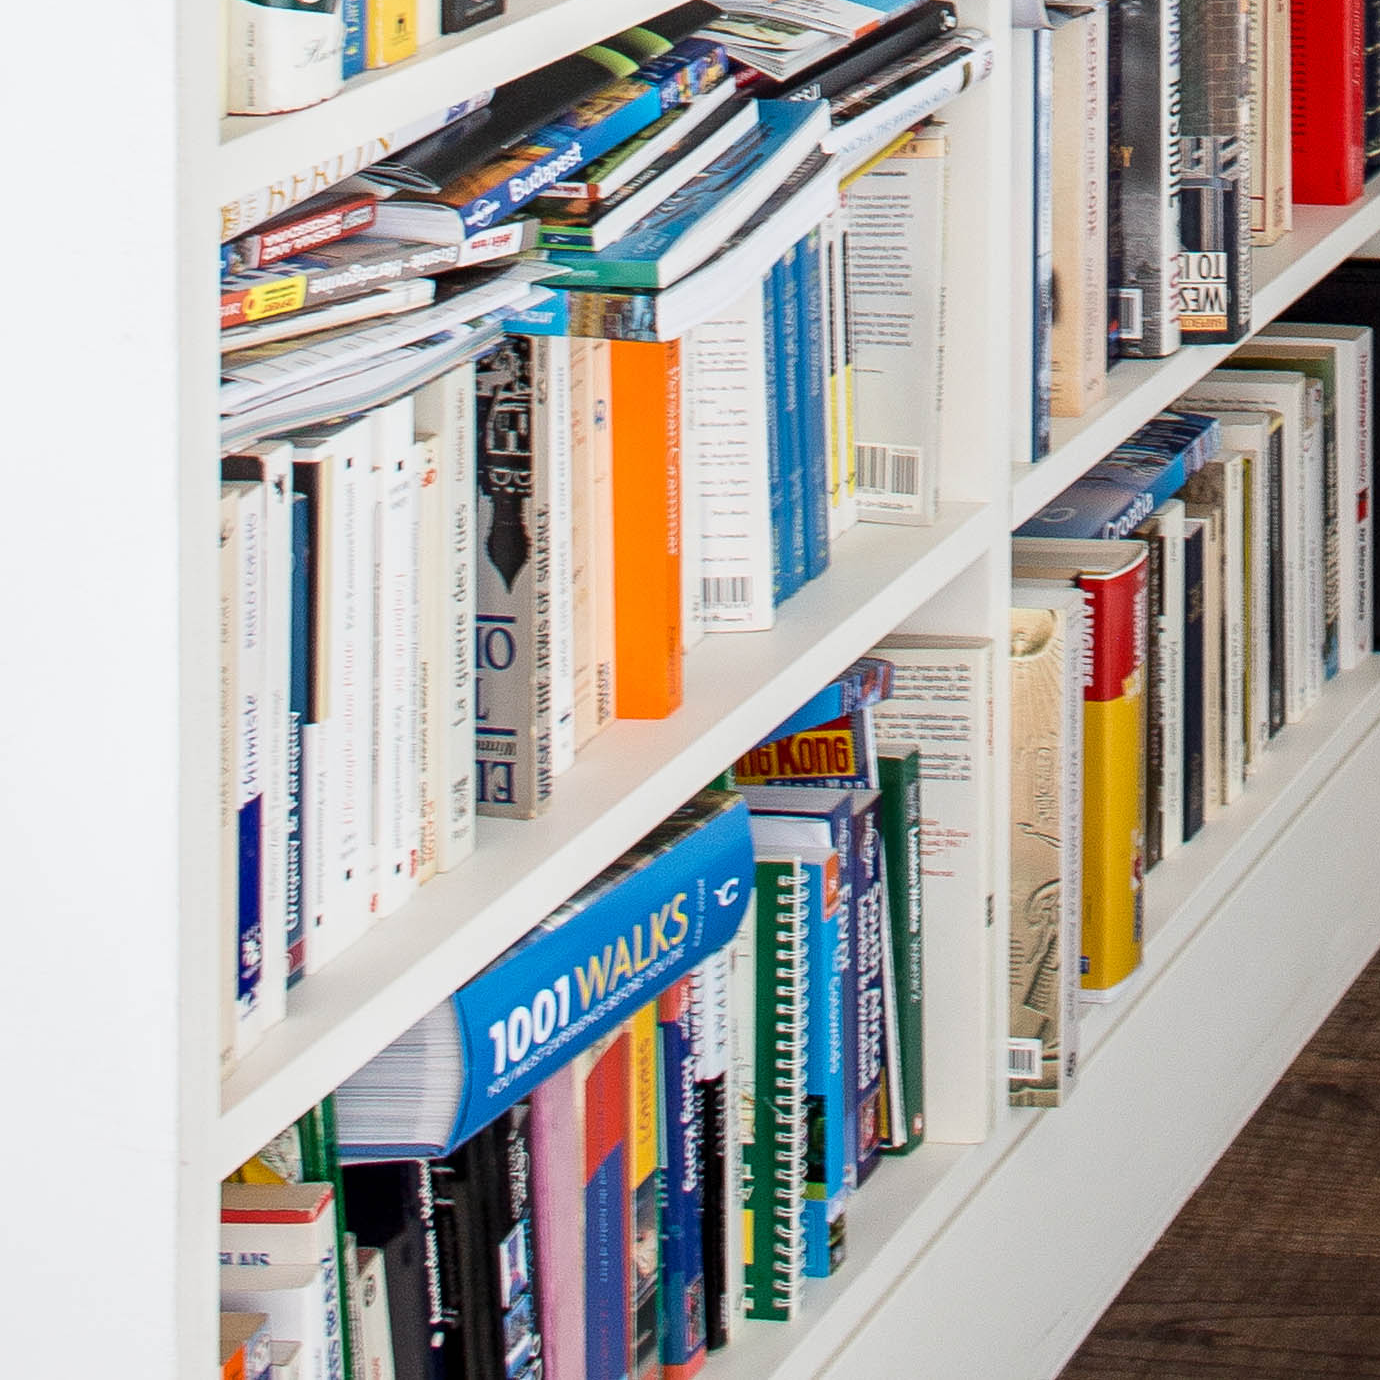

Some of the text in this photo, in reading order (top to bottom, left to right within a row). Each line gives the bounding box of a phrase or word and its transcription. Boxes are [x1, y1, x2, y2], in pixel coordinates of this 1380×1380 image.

[1087, 22, 1097, 123] SECRETS
[507, 142, 586, 205] Budapest
[1168, 79, 1181, 210] RUSHDIE
[1087, 180, 1097, 242] CODE
[667, 363, 681, 450] Persian
[453, 501, 471, 728] La guerre des rues
[536, 503, 553, 802] WIESEL THE JEWS OF SILENCE
[777, 730, 852, 778] Kong
[489, 893, 689, 1074] 1001 WALKS
[867, 882, 882, 1079] South Africa
[680, 1056, 697, 1192] Hong Kong
